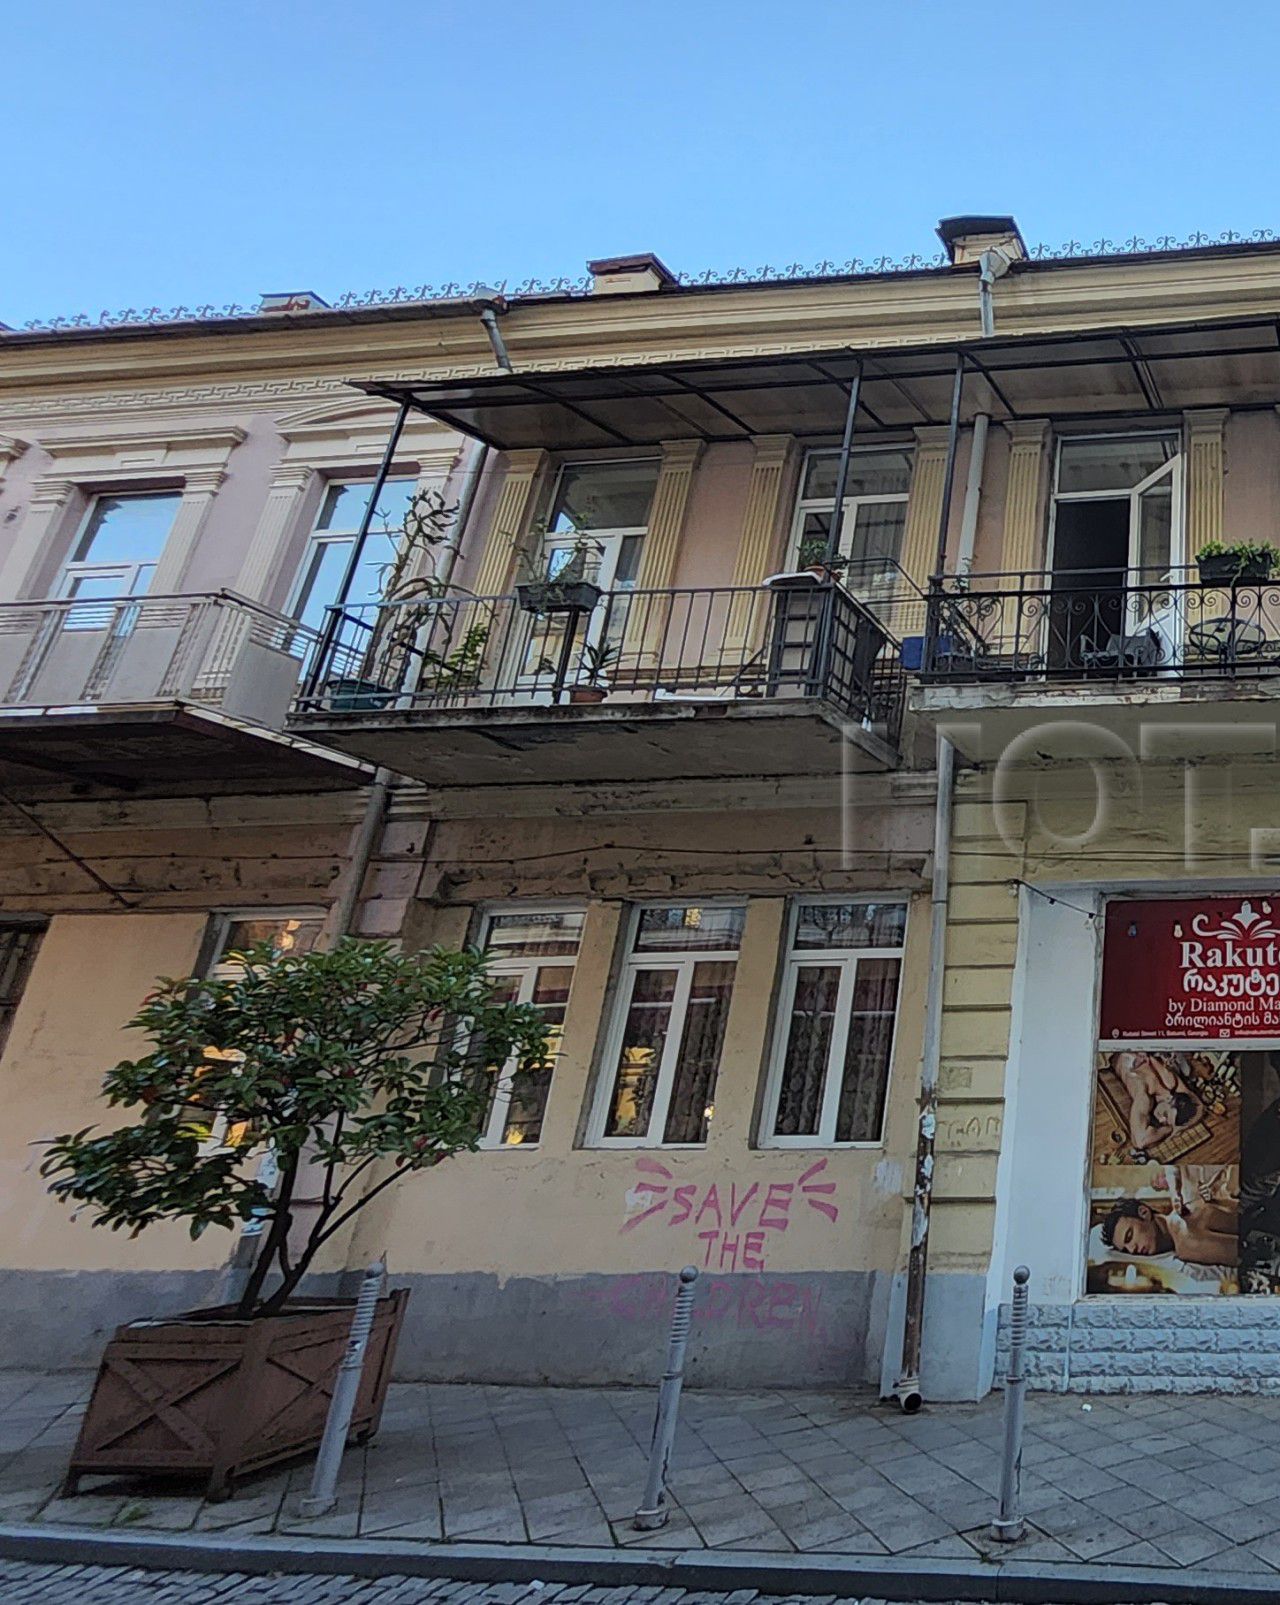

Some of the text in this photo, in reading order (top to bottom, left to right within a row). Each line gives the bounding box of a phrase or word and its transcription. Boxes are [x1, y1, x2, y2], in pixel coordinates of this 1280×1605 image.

[1168, 999, 1186, 1014] by
[1190, 998, 1256, 1013] Diamond
[1165, 1013, 1260, 1029] ბრილიანტის
[668, 1181, 796, 1232] SAVE
[697, 1230, 766, 1273] THE
